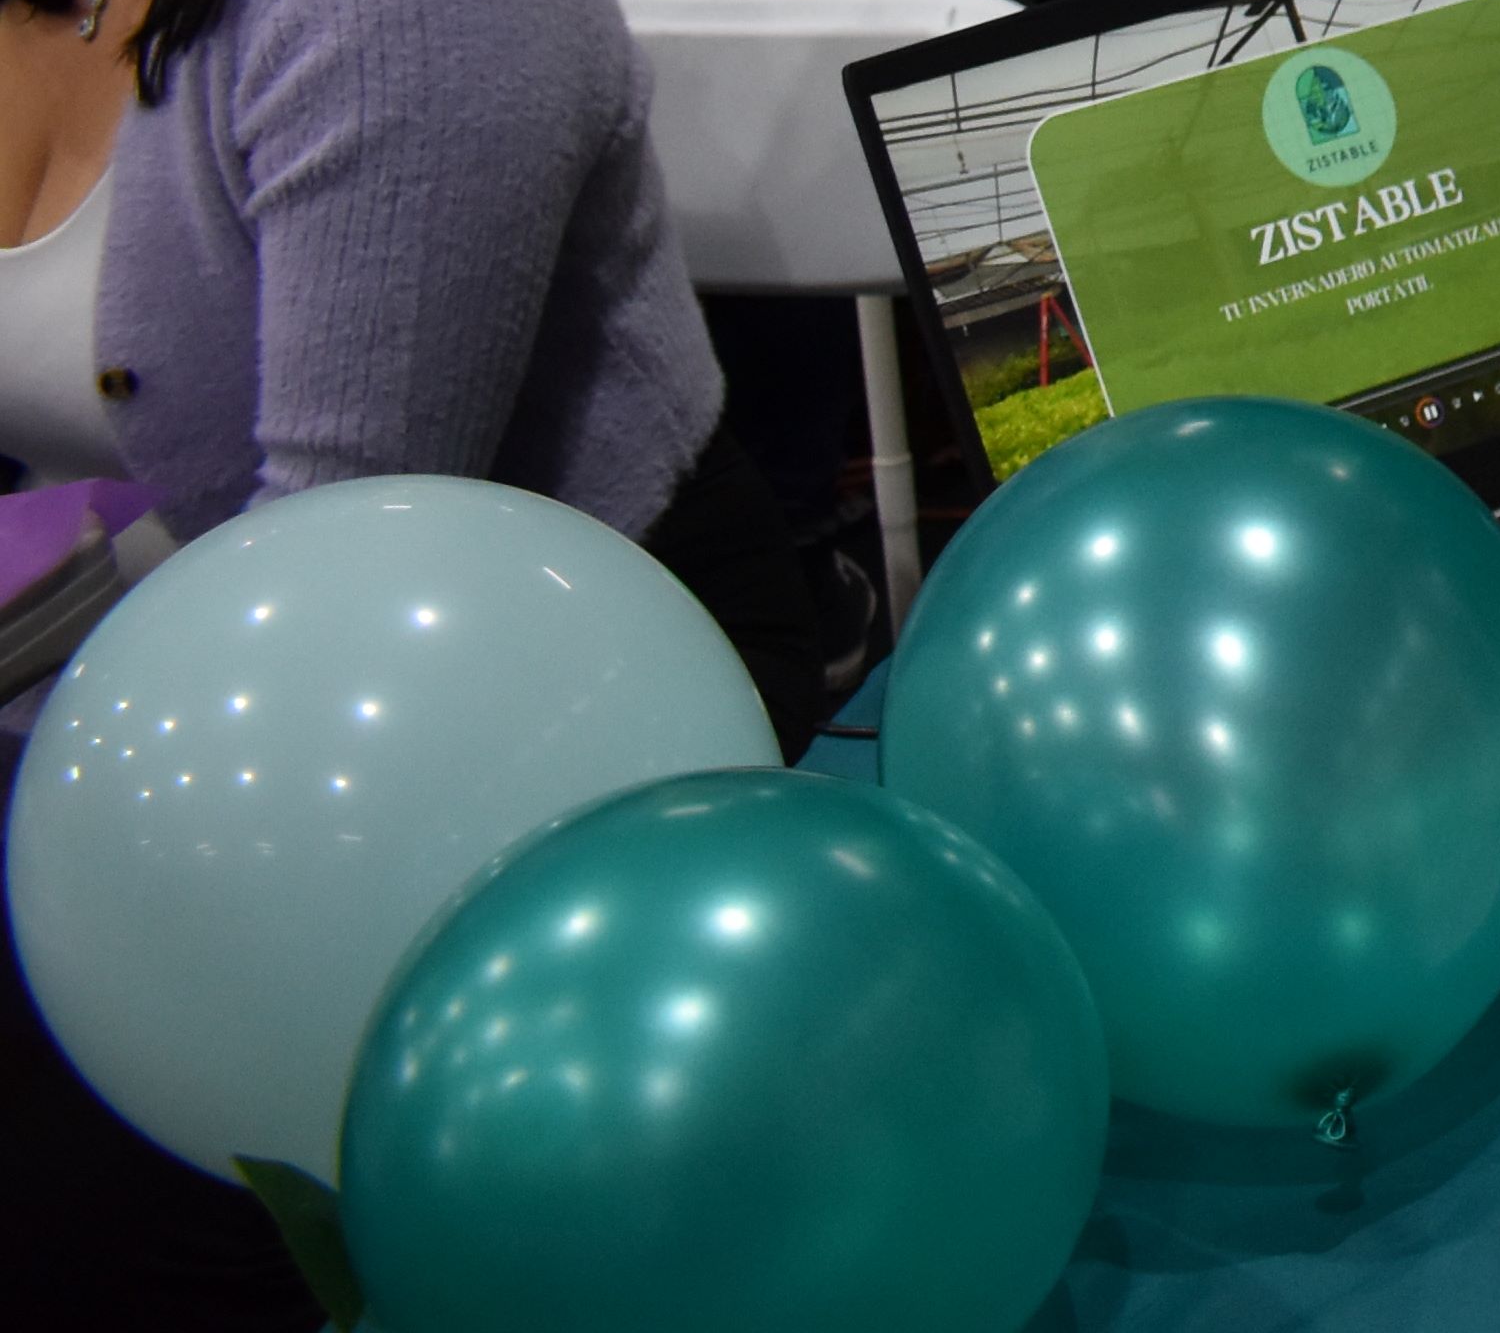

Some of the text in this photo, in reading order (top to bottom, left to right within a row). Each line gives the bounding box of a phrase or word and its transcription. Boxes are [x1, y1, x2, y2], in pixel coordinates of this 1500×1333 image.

[1306, 139, 1379, 174] ZISTABLE
[1251, 168, 1463, 265] ZISTABLE
[1219, 302, 1247, 322] TU
[1249, 259, 1375, 315] INVERNADERO
[1346, 274, 1434, 315] PORTÁTIL
